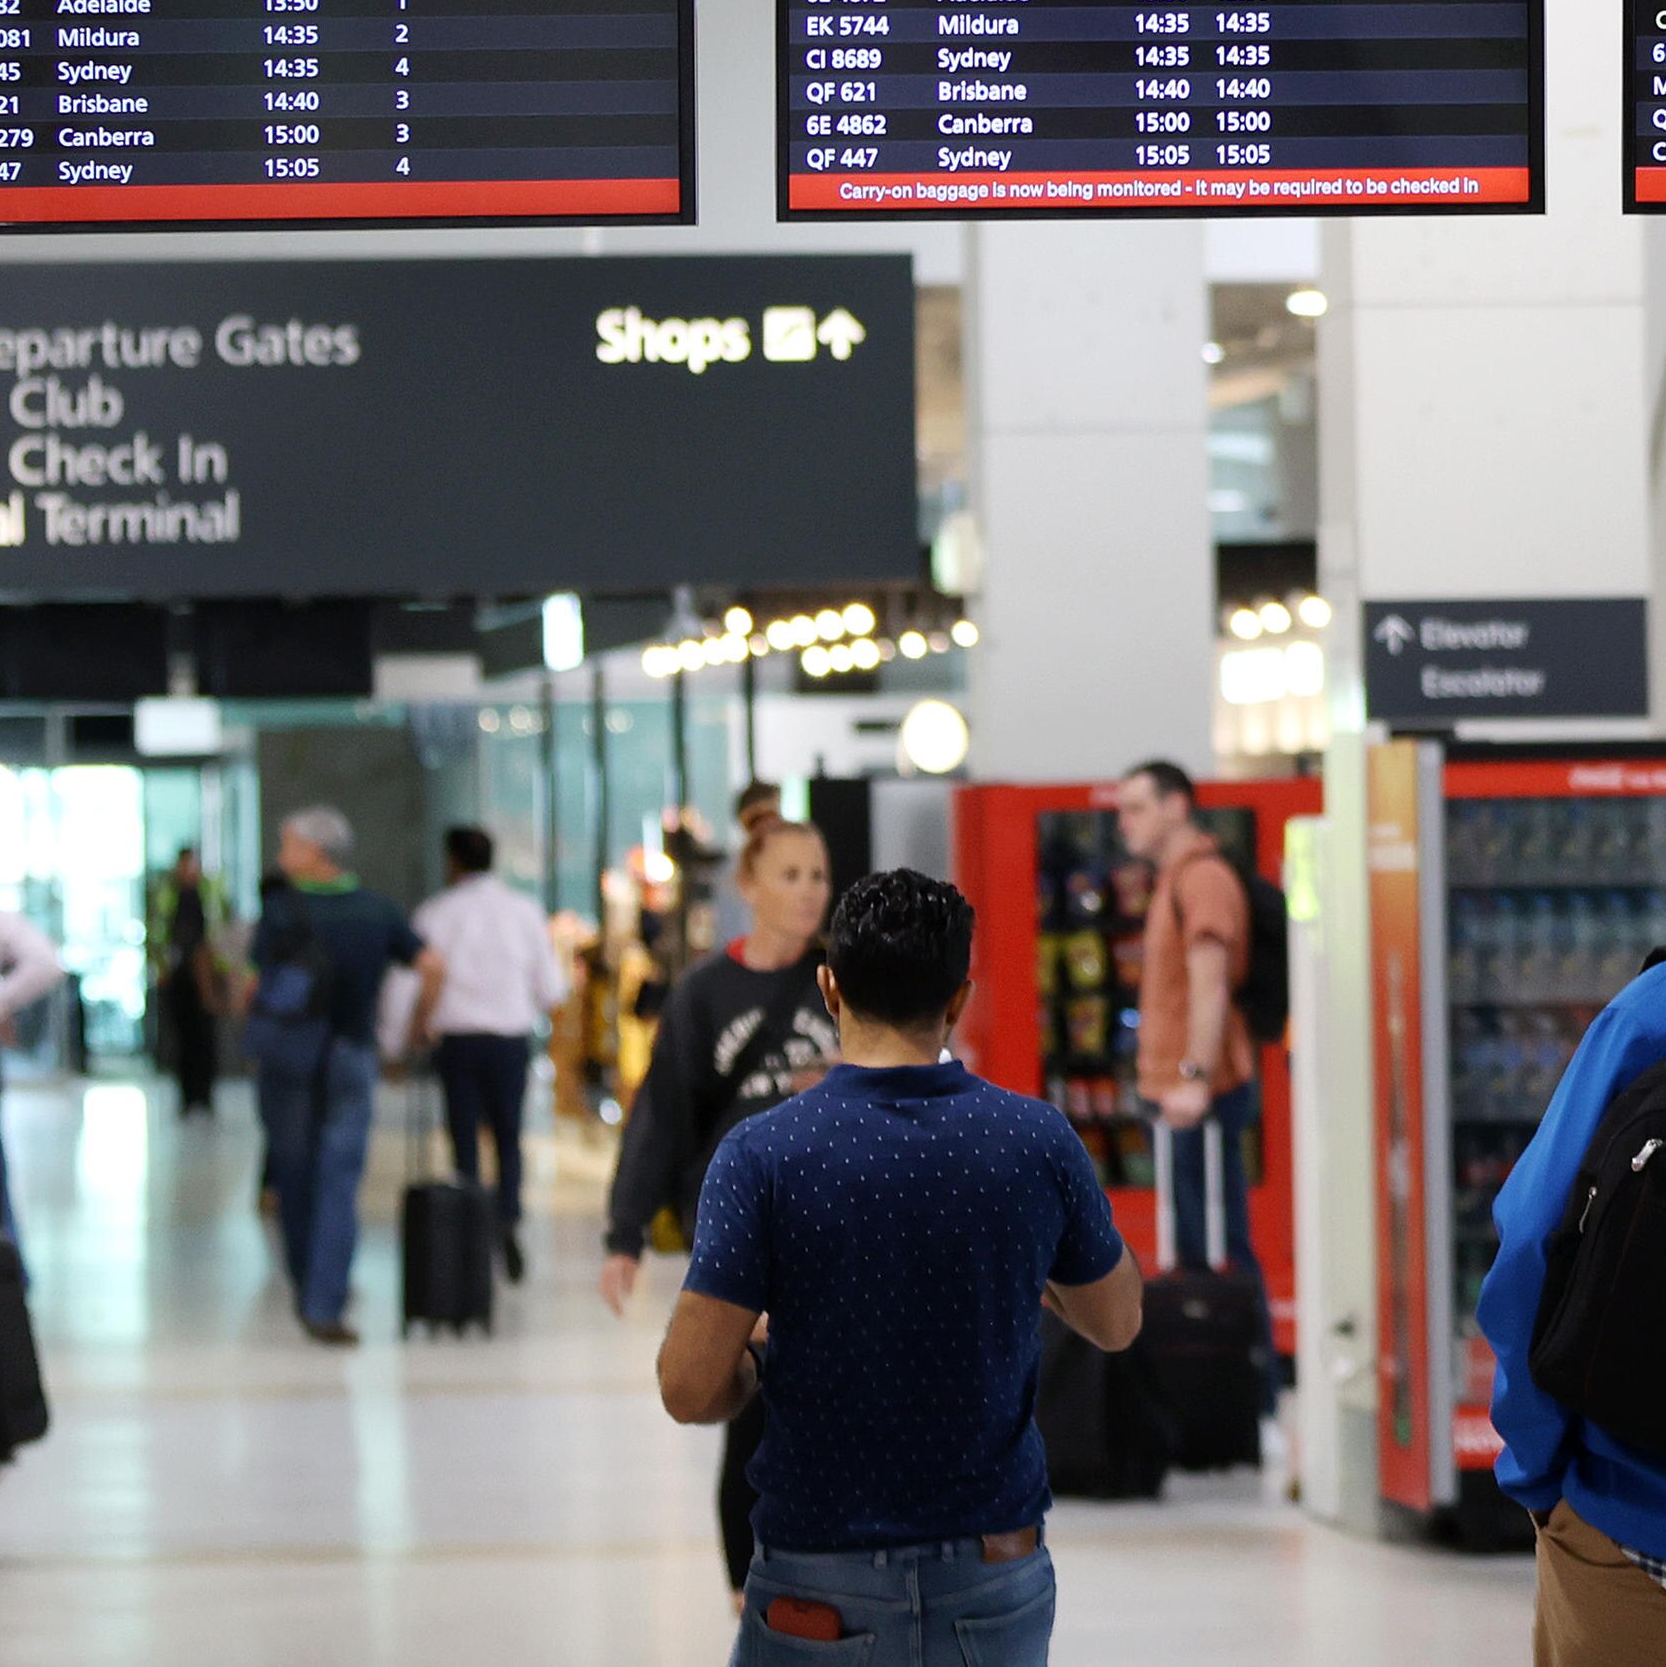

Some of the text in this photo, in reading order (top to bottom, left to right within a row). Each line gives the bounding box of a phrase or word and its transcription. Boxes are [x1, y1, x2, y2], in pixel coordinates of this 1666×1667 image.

[58, 160, 133, 185] Sydney
[264, 158, 320, 177] 15:05
[395, 156, 411, 176] 4
[806, 144, 1271, 172] QF 447 Sydney 15:05 15:05
[215, 313, 359, 367] Gates
[595, 305, 752, 375] Shops
[9, 374, 123, 434] Club
[8, 433, 228, 493] Check In
[34, 488, 241, 547] Terminal
